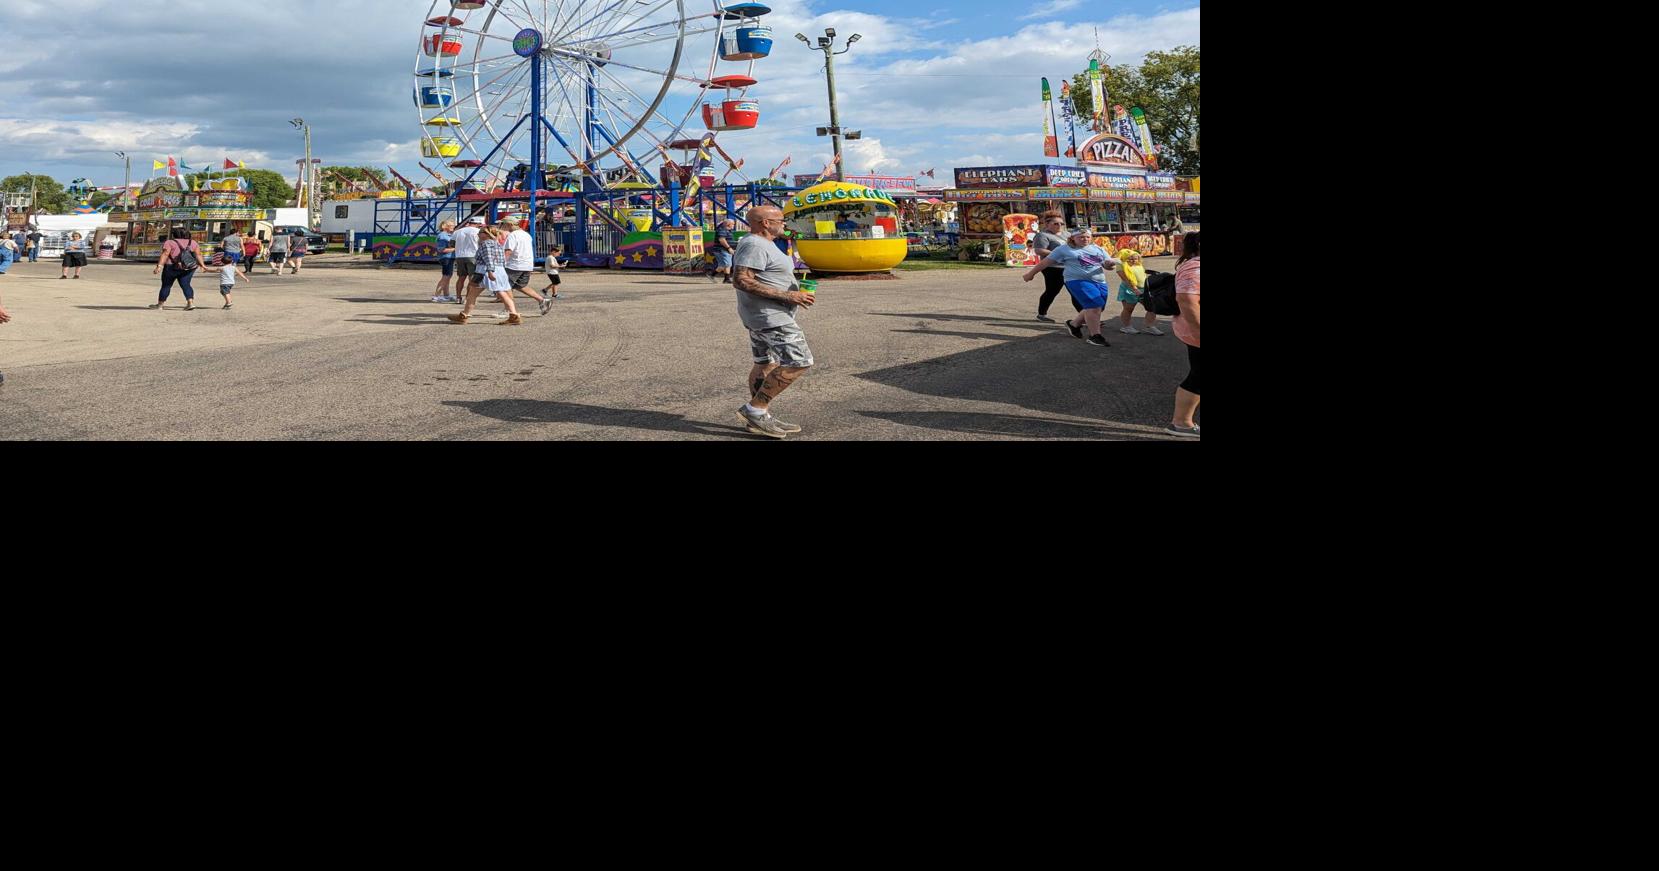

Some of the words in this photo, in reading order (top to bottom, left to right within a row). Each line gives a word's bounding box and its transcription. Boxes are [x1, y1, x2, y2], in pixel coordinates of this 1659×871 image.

[1092, 140, 1134, 163] PIZZA!
[964, 168, 1034, 178] ELEPHANT
[1049, 168, 1065, 177] DEEP
[666, 245, 686, 254] ATM
[692, 245, 703, 254] ATM
